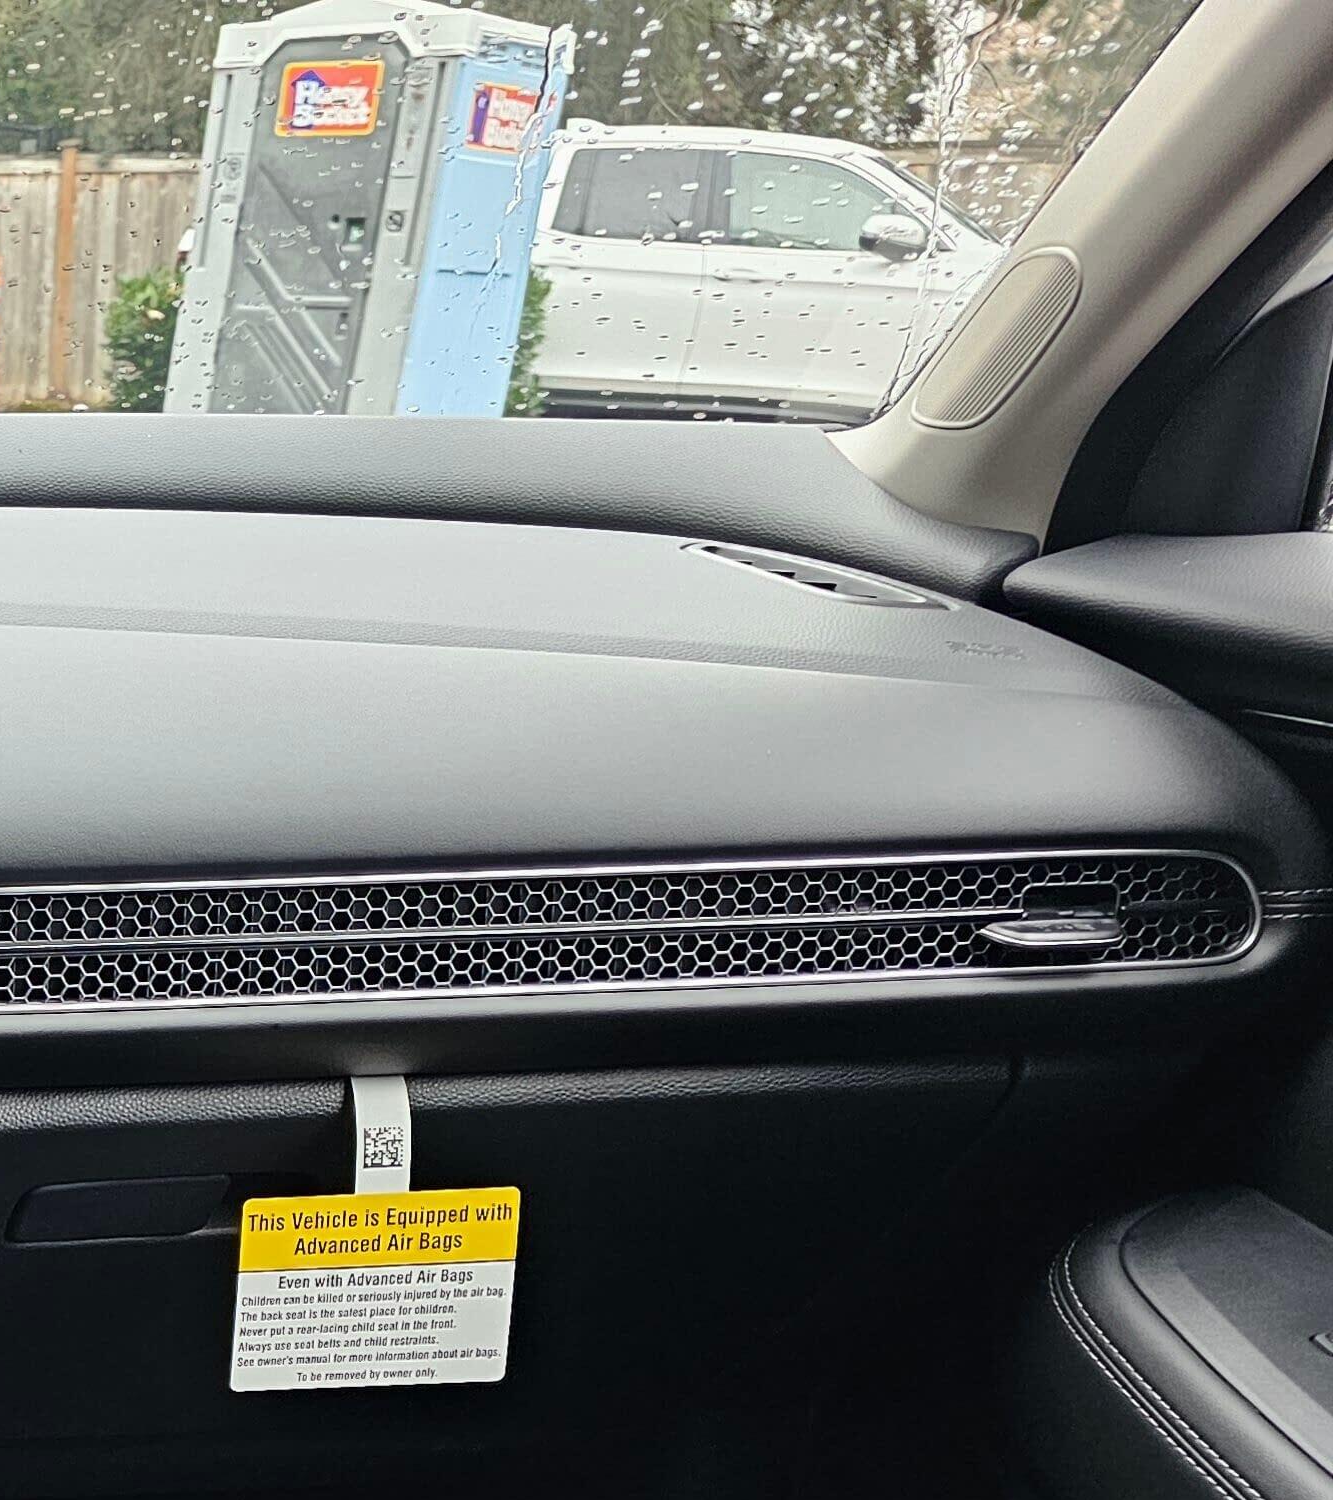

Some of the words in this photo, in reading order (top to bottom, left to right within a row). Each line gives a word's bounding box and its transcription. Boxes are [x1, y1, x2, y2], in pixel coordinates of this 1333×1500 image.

[248, 1213, 285, 1232] This
[292, 1209, 358, 1230] Vehicle
[364, 1208, 380, 1227] is
[386, 1204, 469, 1228] Equipped
[475, 1203, 512, 1222] with
[294, 1235, 381, 1256] Advanced
[386, 1234, 414, 1252] Air
[419, 1233, 463, 1253] Bags
[278, 1275, 310, 1290] Even
[314, 1274, 343, 1288] with
[346, 1271, 413, 1287] Advanced
[416, 1270, 437, 1284] Air
[440, 1270, 474, 1285] Bags
[241, 1295, 281, 1307] Children
[283, 1296, 301, 1305] can
[303, 1294, 315, 1305] be
[317, 1293, 344, 1304] killed
[346, 1294, 357, 1303] or
[358, 1290, 402, 1303] seriously
[403, 1288, 438, 1302] injured
[439, 1288, 452, 1301] by
[453, 1288, 468, 1298] the
[470, 1287, 484, 1298] air
[486, 1286, 507, 1298] bag.
[240, 1311, 258, 1322] The
[260, 1310, 283, 1322] back
[285, 1310, 307, 1321] seat
[308, 1308, 318, 1319] is
[320, 1308, 336, 1319] the
[338, 1307, 367, 1318] safest
[369, 1306, 396, 1319] place
[398, 1305, 413, 1316] for
[414, 1304, 457, 1315] children.
[239, 1327, 268, 1337] Never
[270, 1325, 286, 1338] put
[287, 1326, 294, 1336] a
[296, 1323, 349, 1335] rear-facing
[351, 1321, 376, 1333] child
[377, 1321, 399, 1332] seat
[400, 1320, 411, 1331] in
[412, 1320, 428, 1330] the
[430, 1319, 457, 1330] front.
[237, 1342, 272, 1354] Always
[274, 1342, 292, 1351] use
[294, 1339, 315, 1350] seat
[317, 1338, 342, 1349] belts
[343, 1337, 362, 1348] and
[364, 1336, 388, 1347] child
[390, 1334, 440, 1346] restraints.
[237, 1357, 255, 1368] See
[257, 1355, 294, 1367] owner's
[295, 1353, 331, 1365] manual
[333, 1353, 347, 1363] for
[348, 1353, 373, 1363] more
[375, 1350, 430, 1361] information
[431, 1349, 458, 1360] about
[459, 1348, 474, 1359] air
[475, 1348, 501, 1359] bags.
[296, 1372, 308, 1382] To
[310, 1371, 322, 1382] be
[324, 1369, 367, 1381] removed
[369, 1369, 381, 1381] by
[383, 1370, 413, 1379] owner
[415, 1367, 438, 1379] only.
